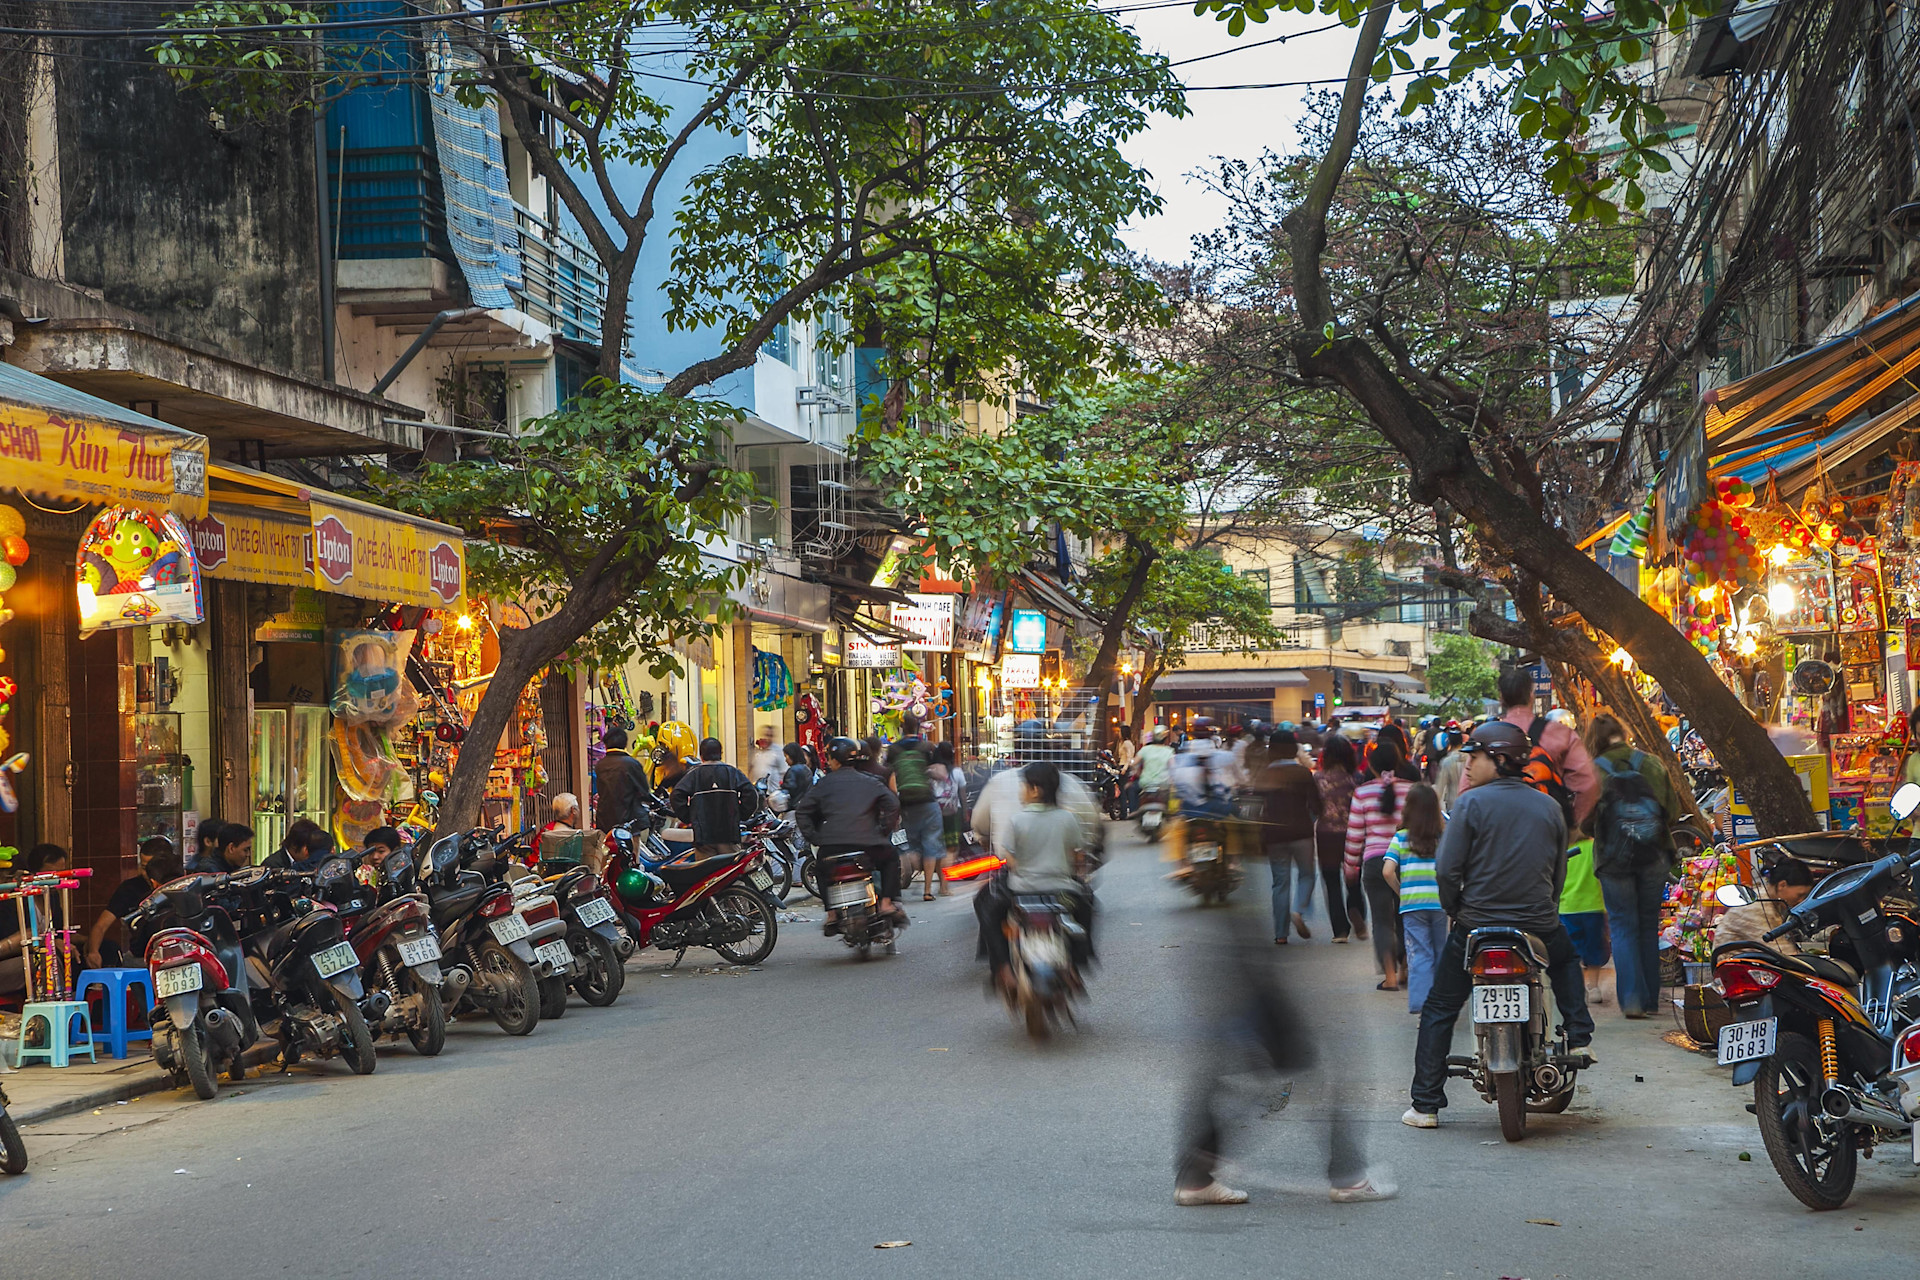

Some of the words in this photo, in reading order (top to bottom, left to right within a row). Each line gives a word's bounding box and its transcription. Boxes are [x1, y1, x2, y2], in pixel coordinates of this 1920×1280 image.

[47, 416, 109, 474] Kim
[316, 530, 350, 568] Lipton
[356, 530, 378, 567] CAFÉ
[432, 555, 458, 589] Lipton
[934, 601, 951, 613] CAFE
[848, 641, 869, 650] SIM
[1005, 677, 1037, 685] AGENCY
[586, 908, 611, 924] 5358
[503, 926, 527, 942] 1029
[404, 941, 431, 954] 30-F4
[408, 949, 436, 964] 5160
[546, 952, 567, 965] 107
[164, 966, 194, 982] 16-K7
[165, 978, 196, 995] 2093
[1482, 988, 1520, 1003] 29-U5
[1483, 1004, 1521, 1019] 1233
[1727, 1022, 1767, 1043] 30-H8
[1726, 1039, 1766, 1060] 0683
